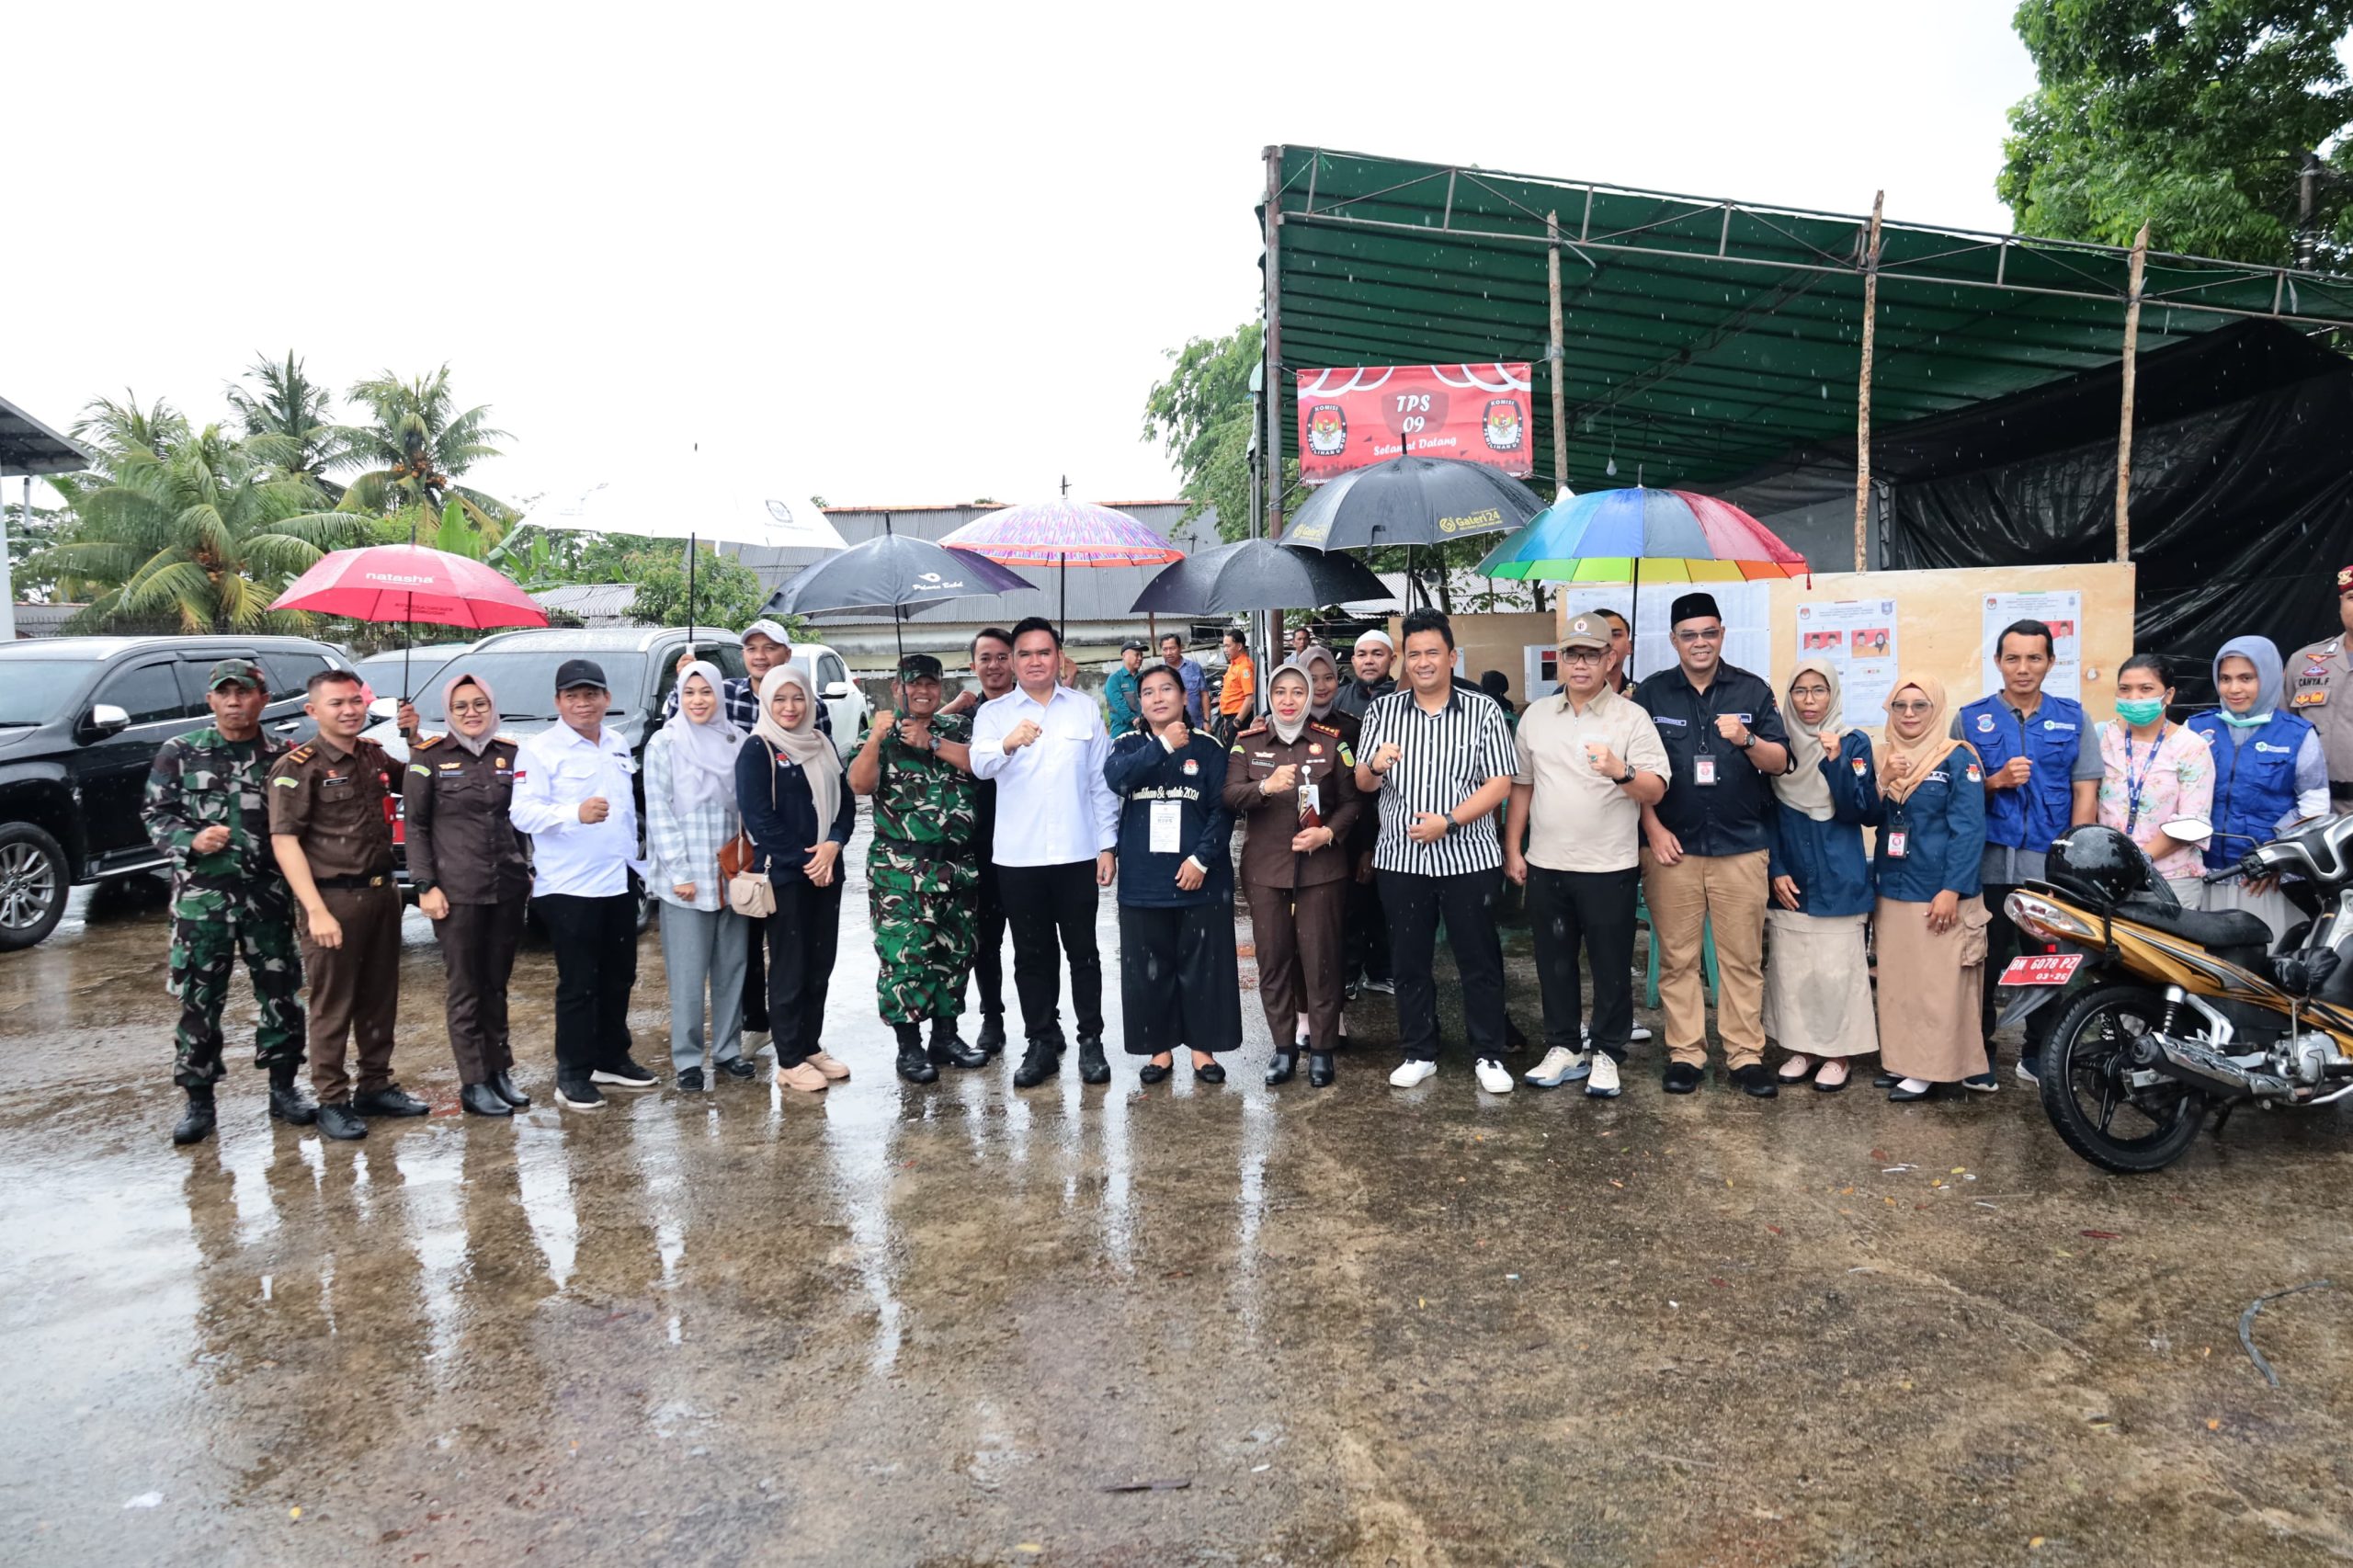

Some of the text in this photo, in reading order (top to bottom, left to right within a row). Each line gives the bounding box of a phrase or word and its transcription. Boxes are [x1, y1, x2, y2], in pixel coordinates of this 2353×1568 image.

[1396, 394, 1431, 413] TPS
[1403, 416, 1425, 433] 09
[1418, 437, 1457, 449] Datang
[1455, 513, 1487, 527] Galeri
[1486, 510, 1501, 521] 24
[365, 573, 434, 584] natasha
[1183, 787, 1199, 801] 2024
[2030, 958, 2059, 971] 6078
[2059, 957, 2078, 970] PZ
